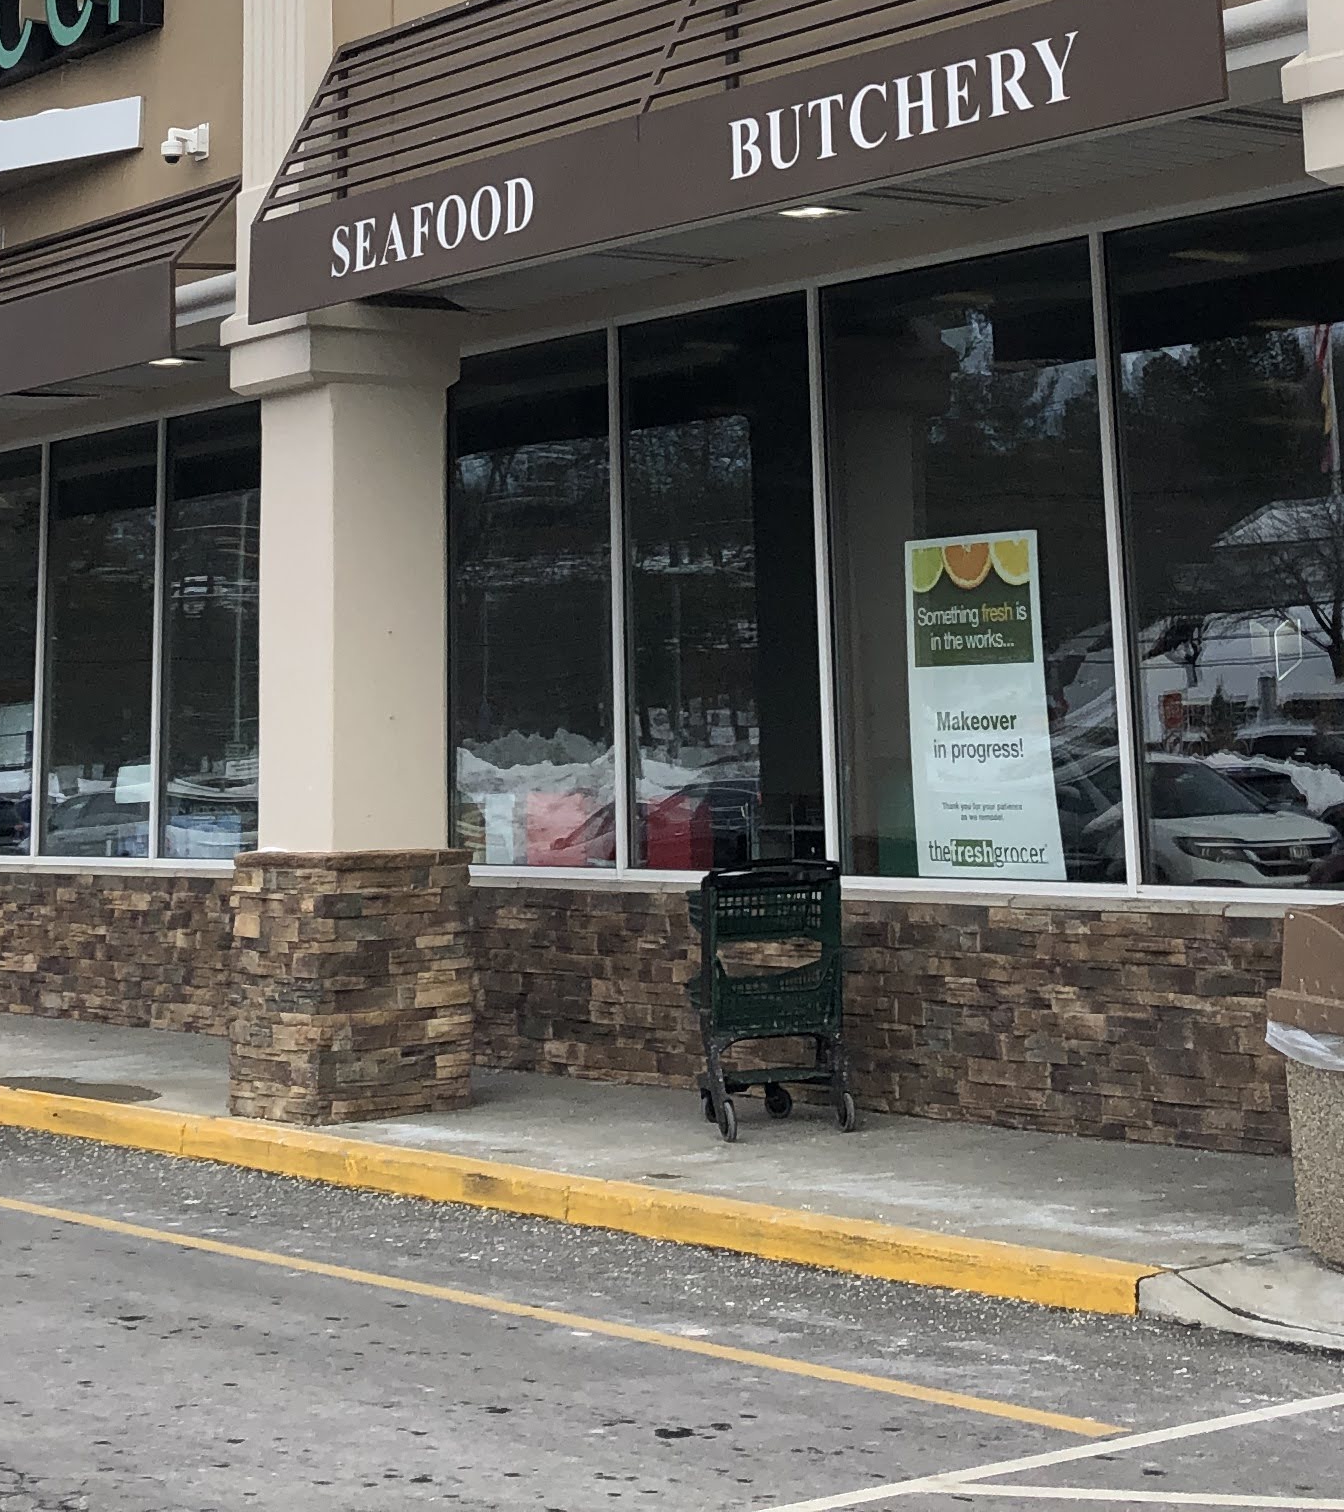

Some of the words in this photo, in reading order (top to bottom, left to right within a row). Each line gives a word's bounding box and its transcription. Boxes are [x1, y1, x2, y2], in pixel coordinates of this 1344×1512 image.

[330, 177, 534, 278] SEAFOOD
[728, 31, 1079, 181] BUTCHERY
[917, 605, 980, 628] Something
[981, 601, 1014, 623] fresh
[1016, 600, 1028, 621] is
[930, 632, 942, 651] in
[943, 631, 963, 650] the
[936, 710, 1018, 731] Makeover
[933, 738, 947, 759] in
[951, 737, 1025, 764] progress!
